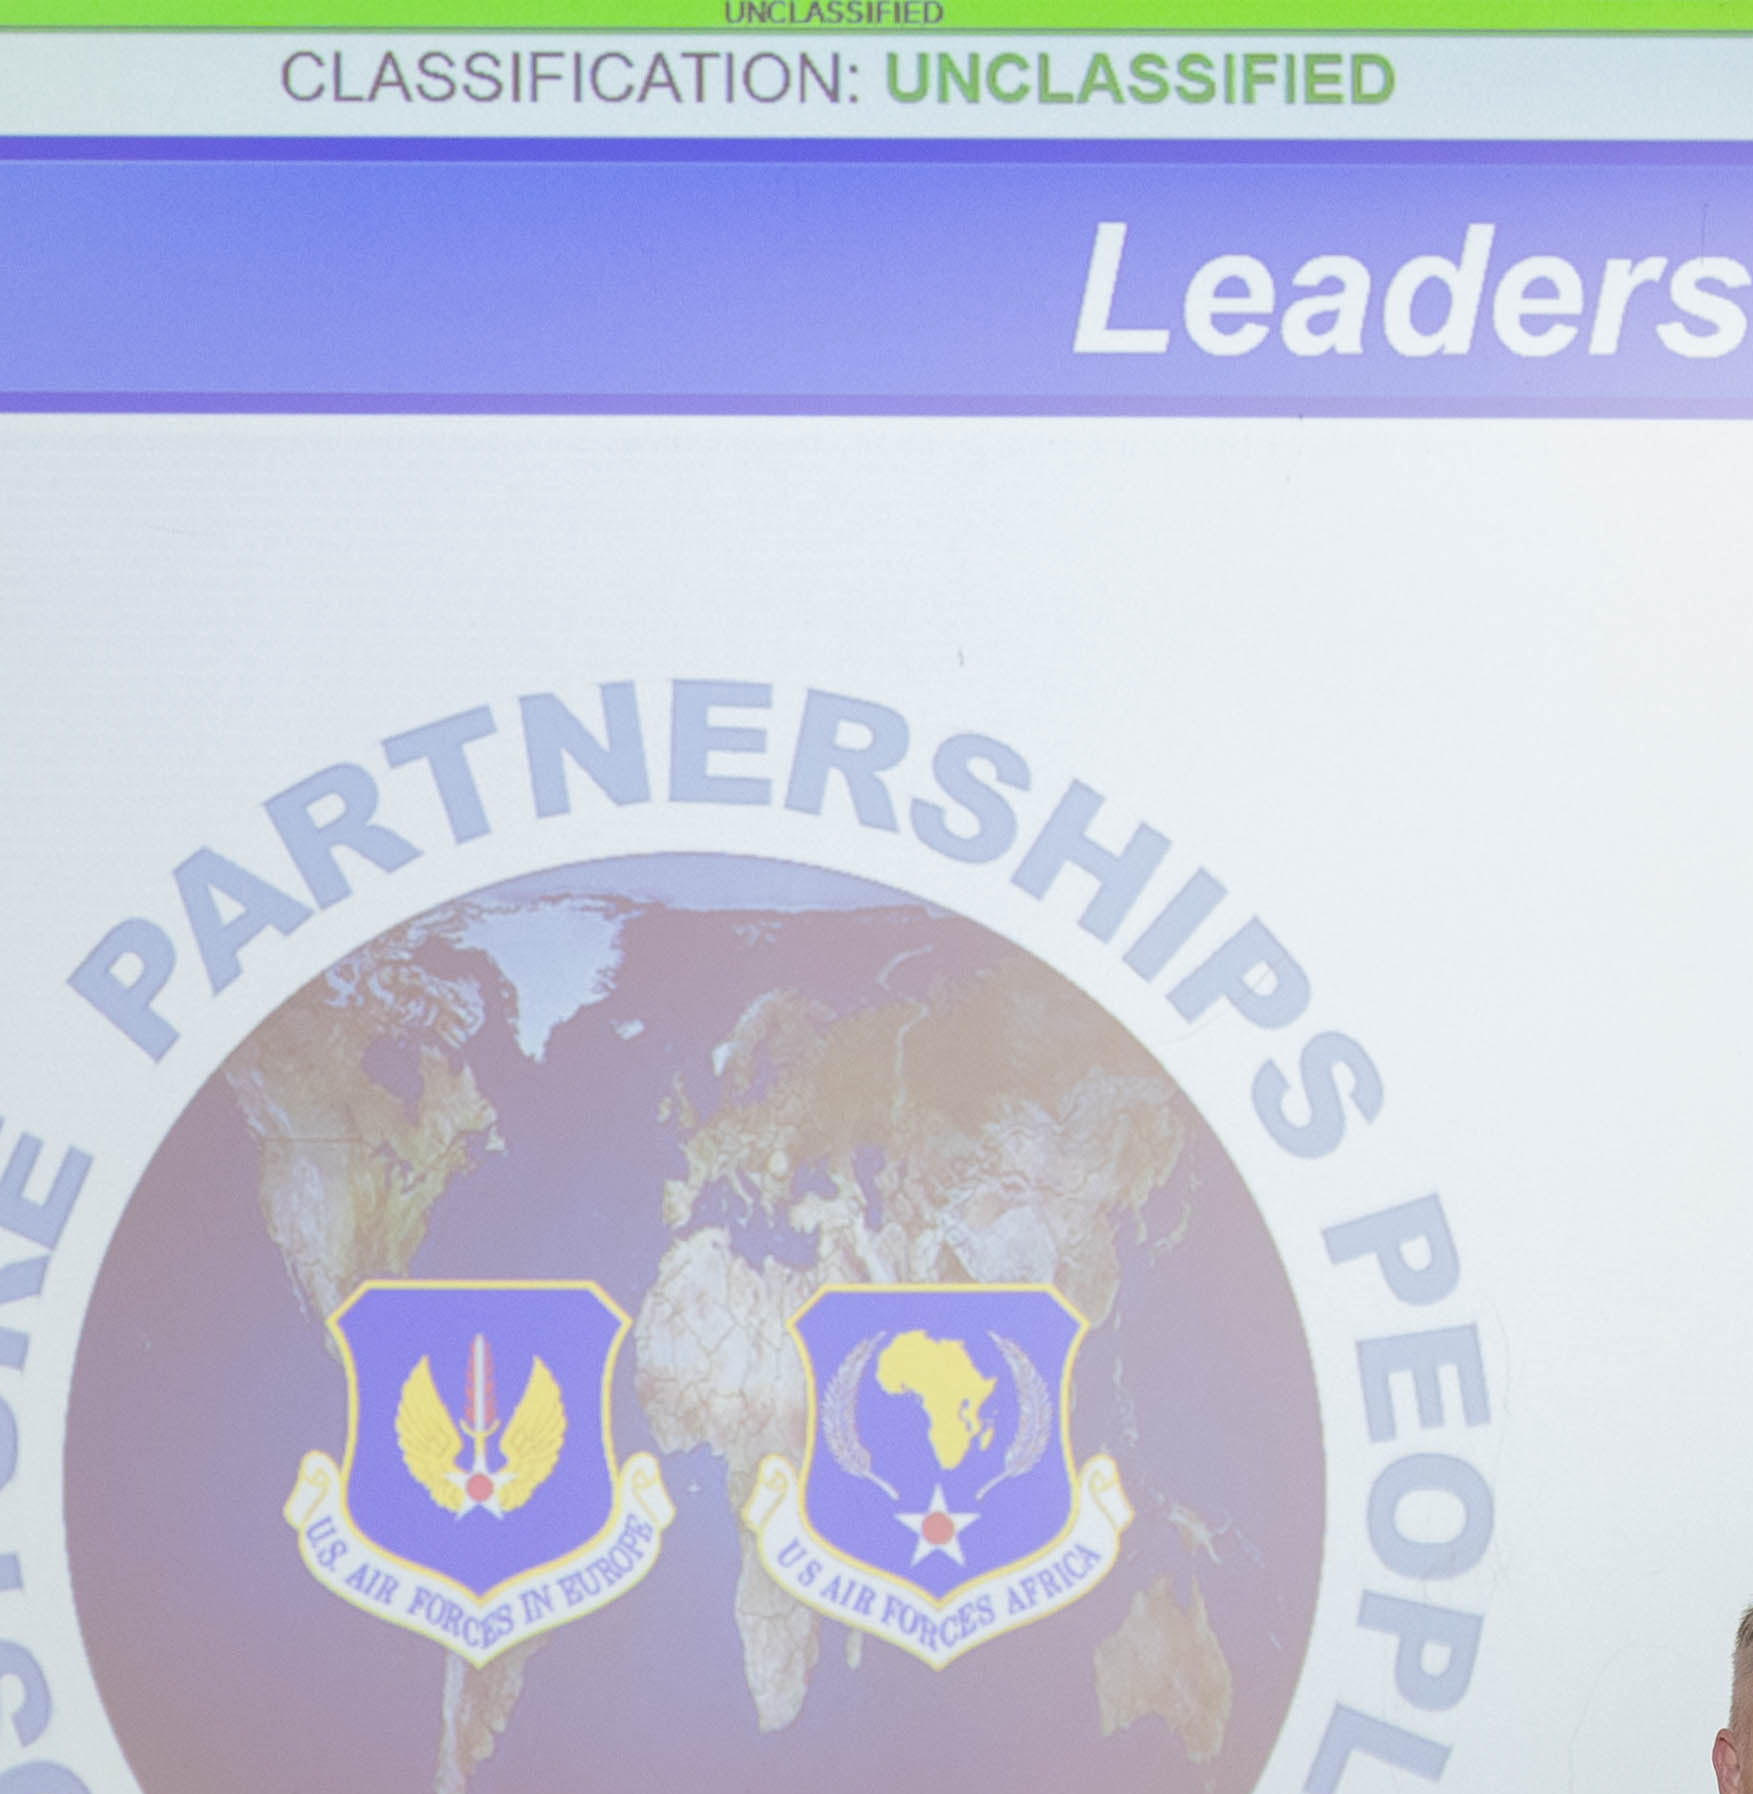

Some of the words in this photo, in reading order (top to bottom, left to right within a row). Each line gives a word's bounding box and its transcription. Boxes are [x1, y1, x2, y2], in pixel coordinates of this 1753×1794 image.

[724, 0, 944, 24] UNCLASSIFIED
[279, 49, 860, 106] CLASSIFICATION:
[885, 51, 1397, 107] UNCLASSIFIED
[66, 677, 1386, 1161] PARTNERSHIPS
[344, 1562, 400, 1606] AIR
[406, 1585, 515, 1650] FORCES
[518, 1582, 553, 1624] IN
[558, 1513, 653, 1608] EUROPE
[819, 1574, 877, 1616] AIR
[880, 1593, 996, 1651] FORCES
[1006, 1543, 1102, 1615] AFRICA
